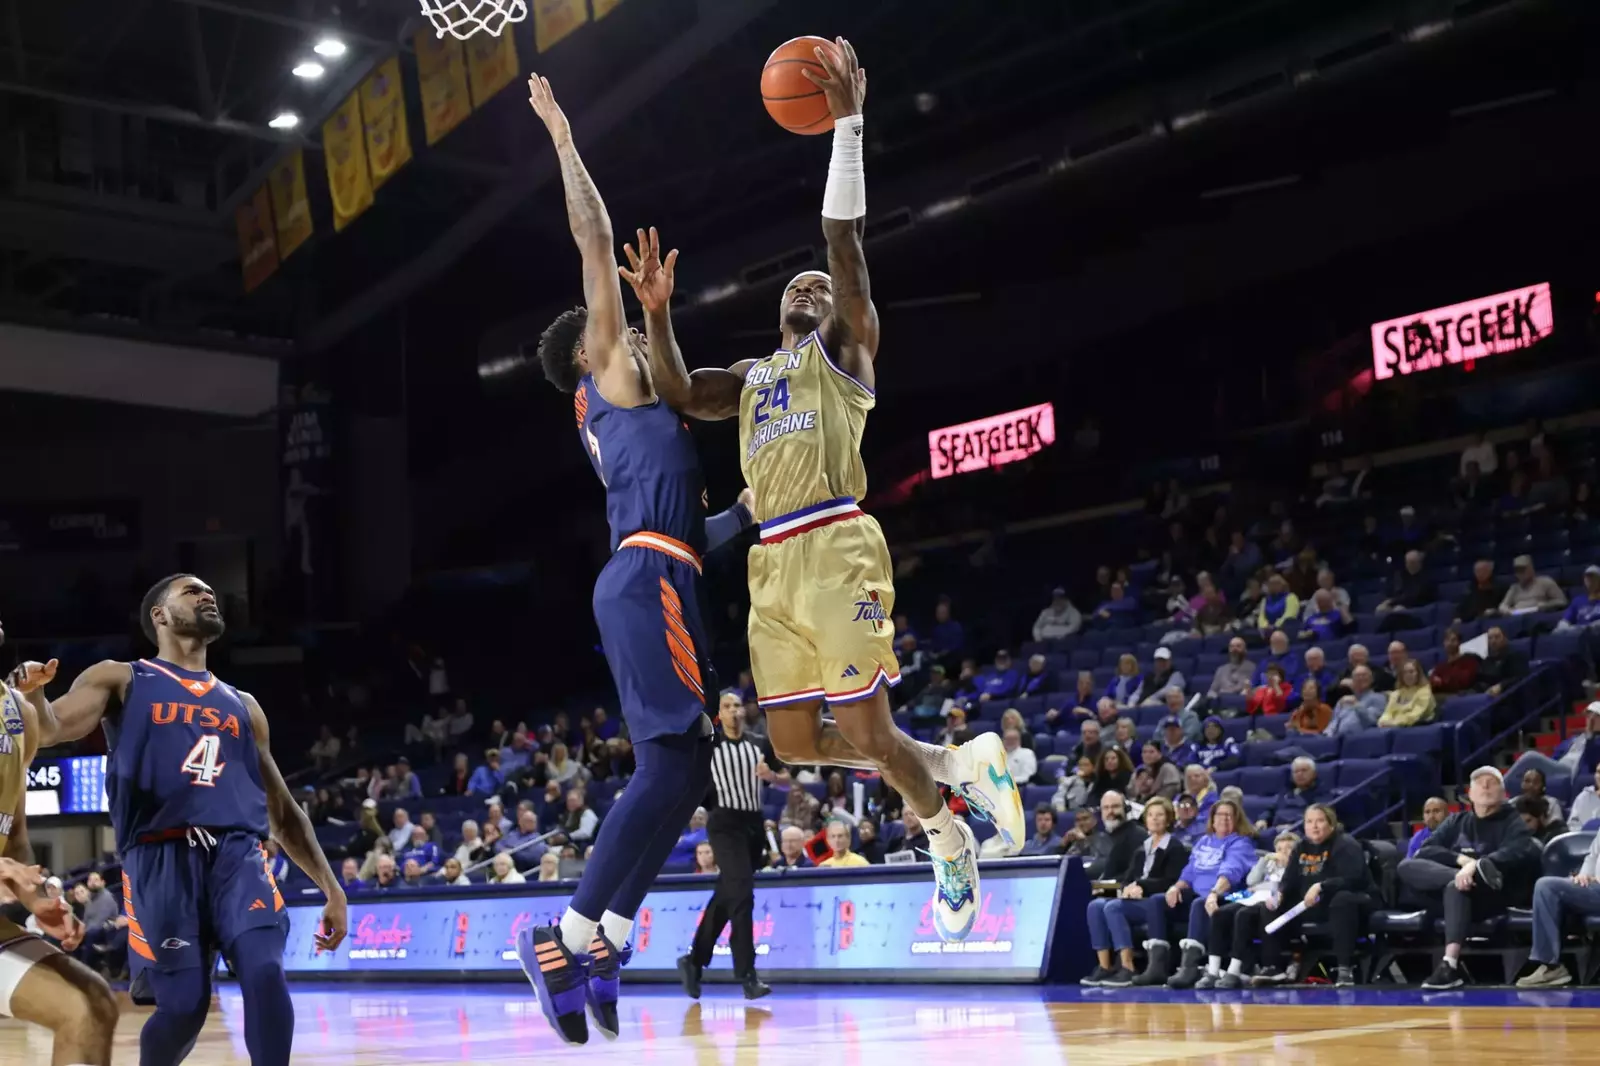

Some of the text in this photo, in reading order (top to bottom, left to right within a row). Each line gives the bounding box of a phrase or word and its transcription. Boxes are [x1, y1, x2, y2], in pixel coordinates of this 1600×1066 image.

[1383, 292, 1539, 369] SEATGEEK
[745, 353, 802, 387] GOLN
[754, 377, 790, 425] 24
[937, 411, 1043, 470] SEATGEEK
[152, 702, 240, 739] UTSA
[181, 734, 226, 787] 4
